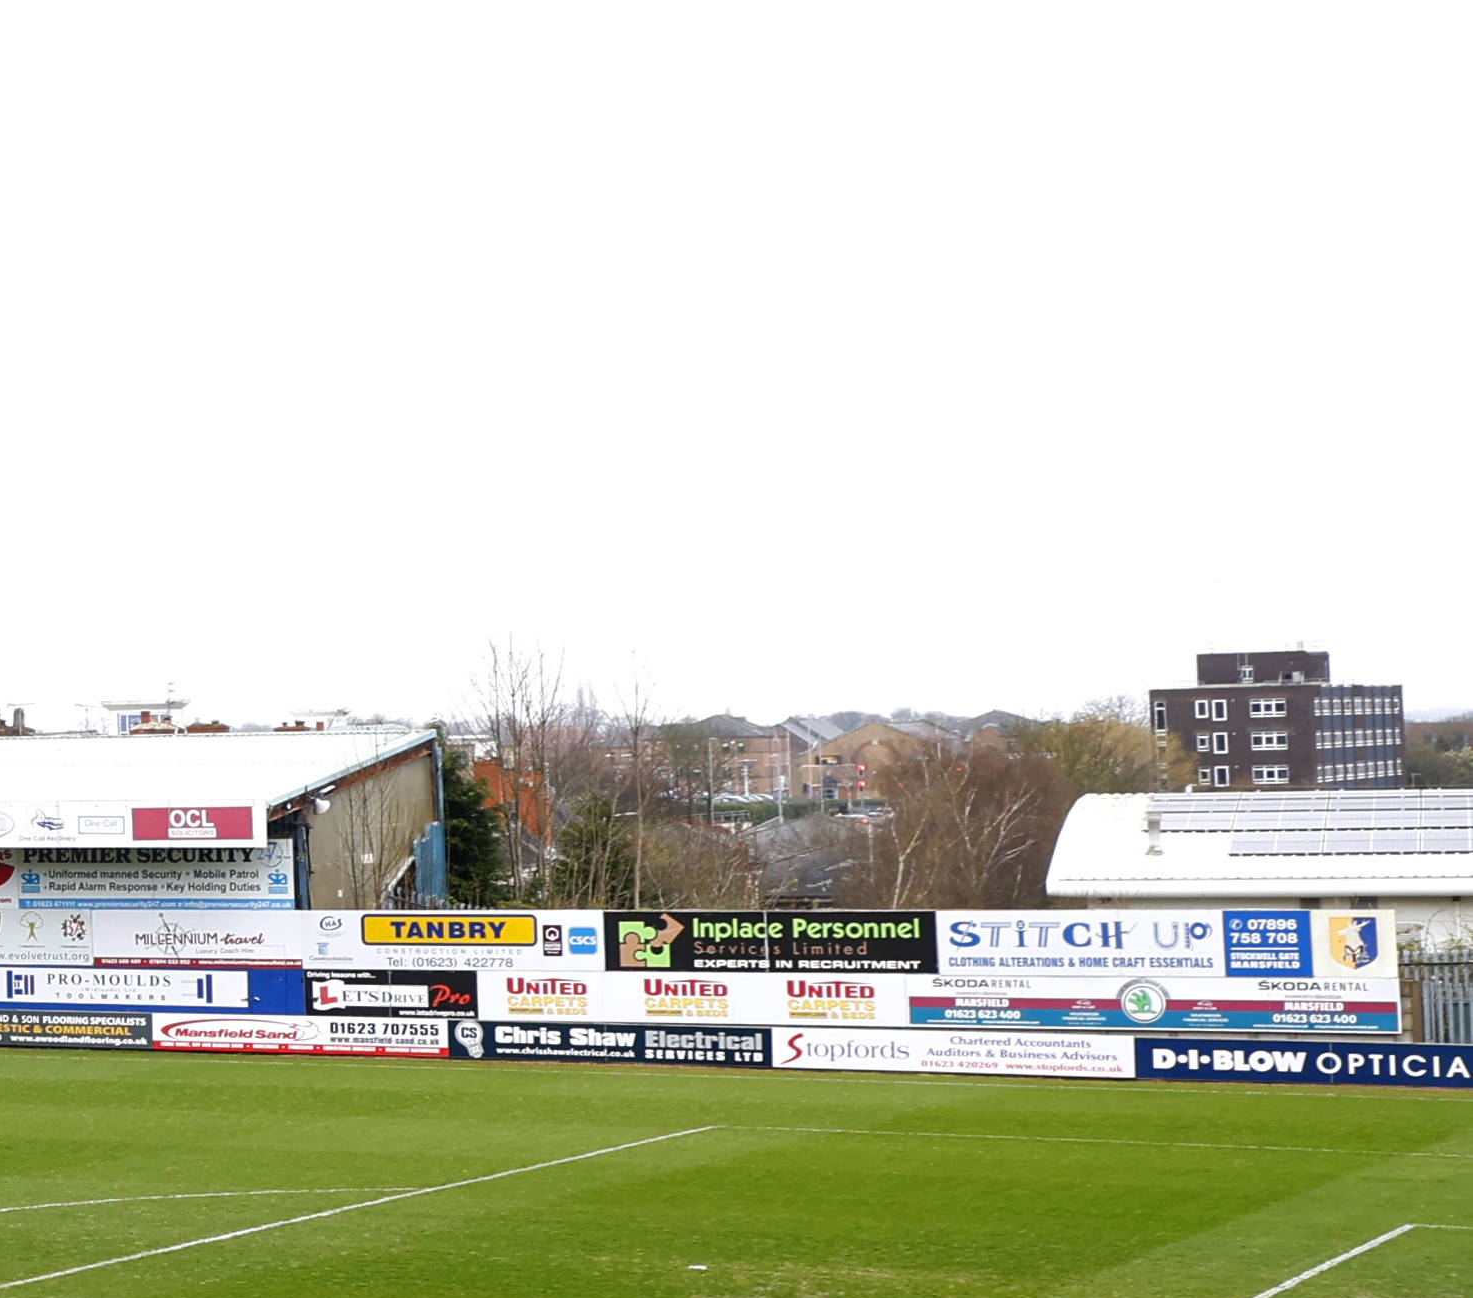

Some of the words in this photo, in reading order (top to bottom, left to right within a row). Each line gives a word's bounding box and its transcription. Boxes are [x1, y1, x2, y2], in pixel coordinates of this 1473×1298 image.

[169, 809, 214, 827] OCL
[22, 847, 132, 863] PREMIER
[143, 847, 254, 863] SECURITY
[109, 882, 158, 893] Response
[391, 921, 507, 939] TANBRY
[693, 918, 783, 941] Inplace
[792, 919, 919, 939] Personnel
[1248, 919, 1297, 930] 07896
[694, 941, 781, 955] Services
[793, 941, 868, 955] Limited
[693, 959, 770, 969] EXPERTS
[776, 960, 791, 969] IN
[798, 960, 921, 969] RECRUITMENT
[949, 957, 995, 968] CLOTHING
[999, 957, 1065, 968] ALTERATIONS
[47, 973, 172, 987] PRO-MOULDS
[44, 1025, 131, 1035] COMMERCIAL
[330, 1023, 375, 1035] 01623
[382, 1024, 439, 1037] 707555
[495, 1026, 561, 1045] Chris
[569, 1027, 635, 1047] Shaw
[645, 1031, 763, 1050] Electrical
[781, 1033, 909, 1065] Stopfords
[950, 1036, 1009, 1047] Chartered
[1013, 1038, 1091, 1048] Accountants
